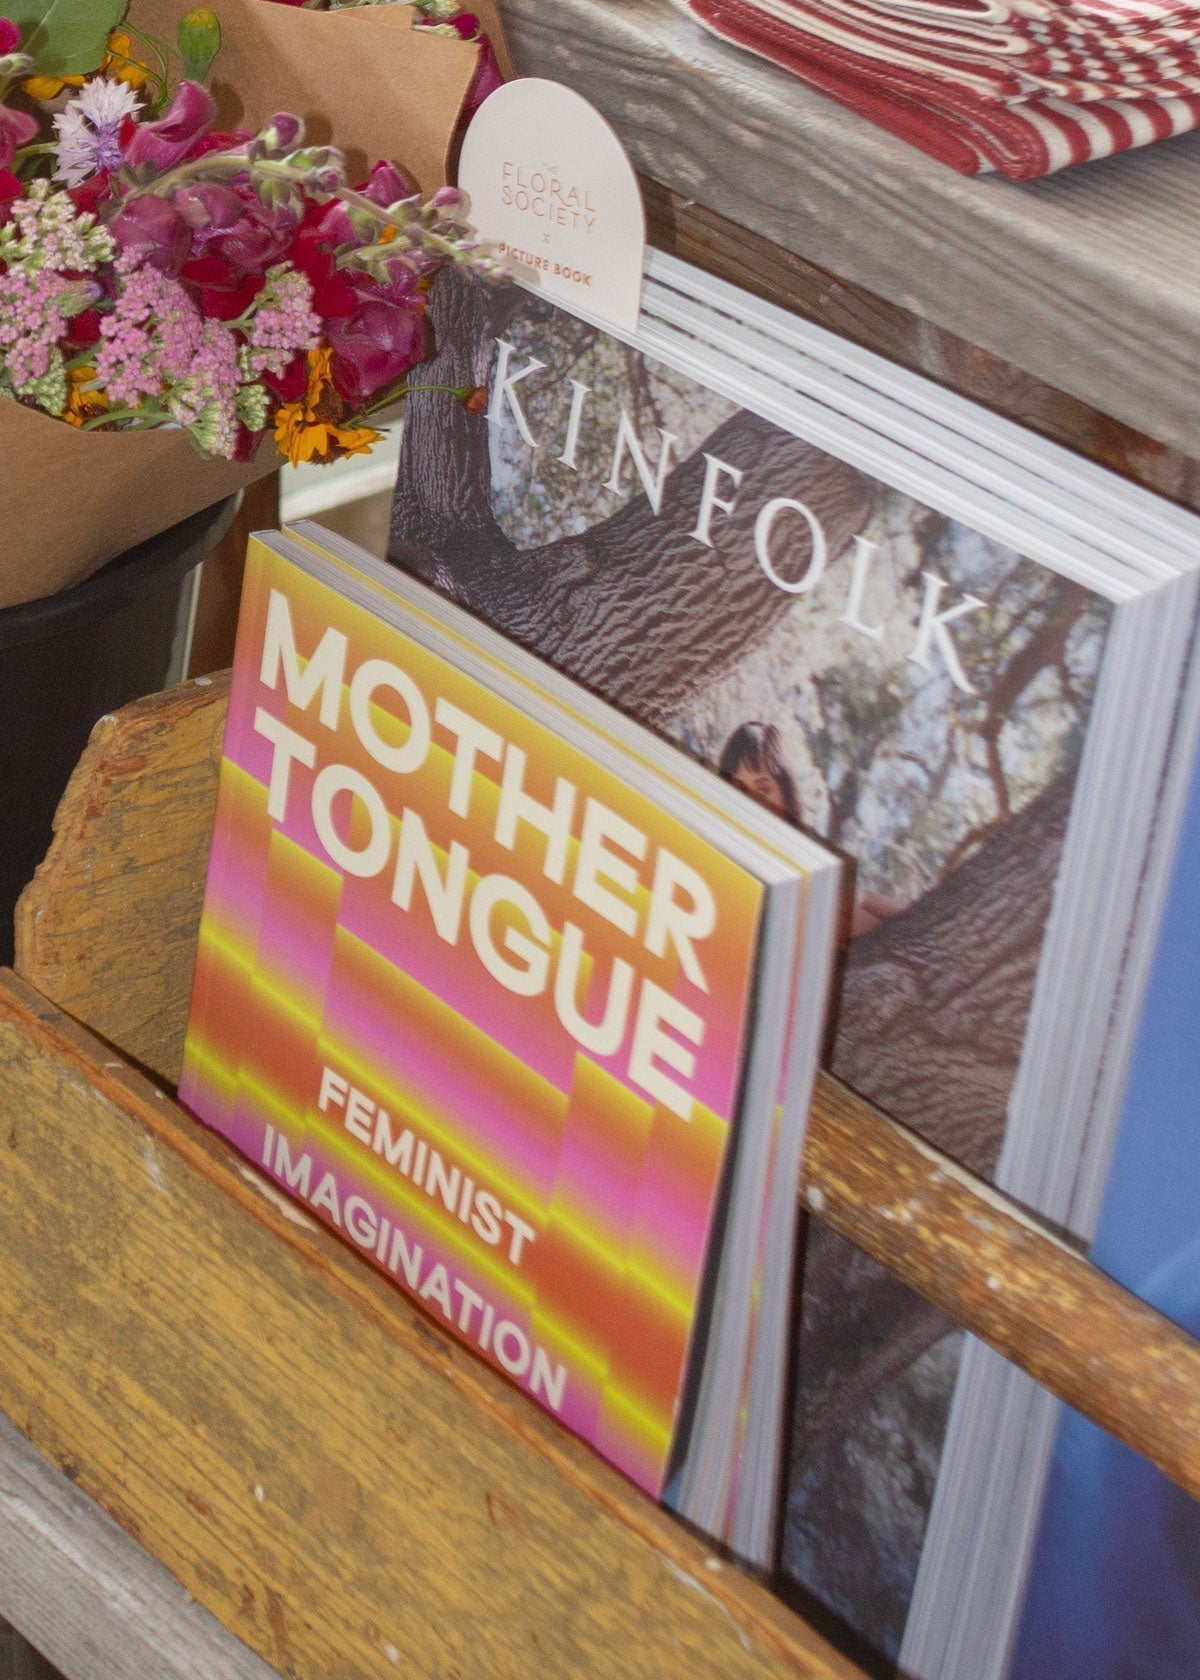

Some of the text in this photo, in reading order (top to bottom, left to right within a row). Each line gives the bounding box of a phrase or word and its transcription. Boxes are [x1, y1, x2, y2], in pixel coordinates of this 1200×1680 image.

[498, 241, 591, 288] PICTURE BOOK
[501, 185, 597, 235] SOCIETY
[502, 161, 597, 213] FLORAL
[484, 337, 988, 694] KINFOLK
[259, 588, 717, 995] MOTHER
[253, 706, 705, 1123] TONGUE
[262, 1123, 567, 1412] IMAGINATION
[317, 1066, 536, 1267] FEMINIST
